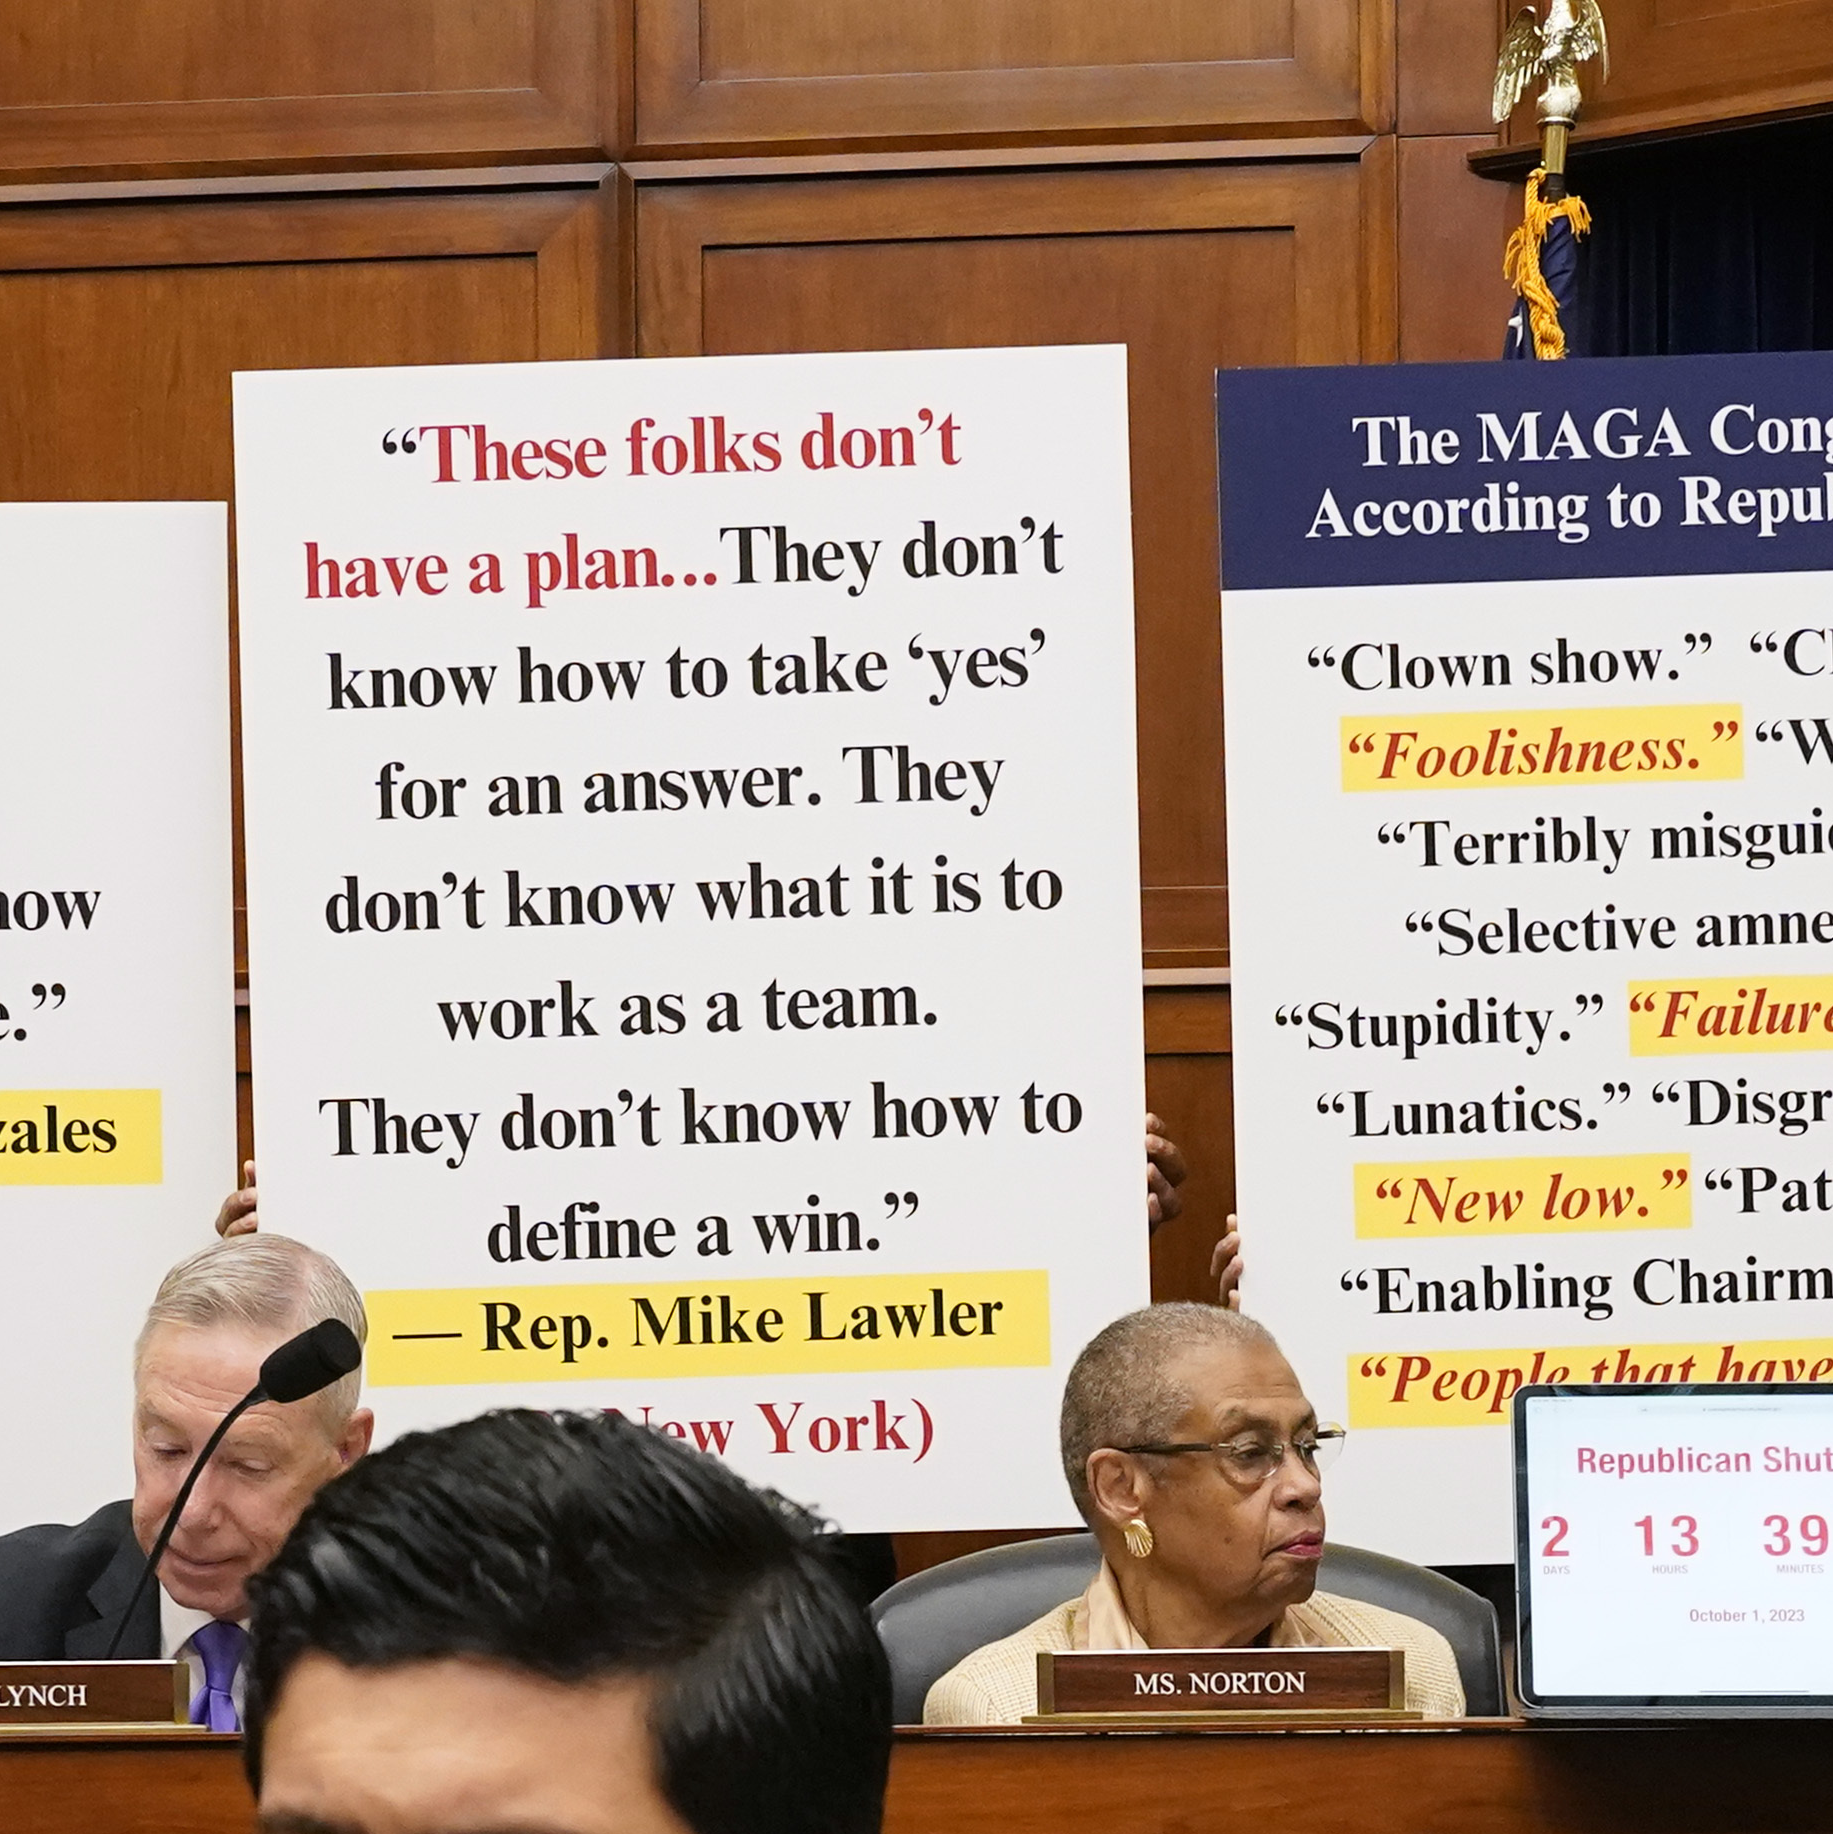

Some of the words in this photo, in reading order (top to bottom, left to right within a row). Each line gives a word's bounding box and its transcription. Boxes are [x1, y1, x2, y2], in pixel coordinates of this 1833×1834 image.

[383, 425, 606, 482] “These
[626, 416, 781, 475] folks
[801, 408, 961, 470] don’t
[1352, 416, 1459, 466] The
[1476, 408, 1691, 462] MAGA
[1305, 482, 1589, 543] According
[1607, 483, 1661, 528] to
[305, 542, 447, 598] have
[469, 554, 504, 593] a
[903, 517, 1063, 578] don’t
[327, 653, 497, 709] know
[518, 647, 645, 703] how
[666, 647, 727, 698] to
[748, 636, 887, 695] take
[909, 628, 1045, 706] ‘yes’
[1308, 644, 1511, 690] “Clown
[1531, 633, 1711, 684] show.”
[1349, 721, 1738, 778] “Foolishness.”
[375, 762, 466, 819] for
[489, 775, 562, 816] an
[584, 767, 820, 813] answer.
[843, 746, 1004, 816] They
[1378, 816, 1630, 874] “Terribly
[326, 872, 485, 933] don’t
[505, 871, 675, 927] know
[696, 862, 849, 920] what
[870, 857, 913, 914] it
[934, 855, 981, 912] is
[1001, 859, 1062, 910] to
[1406, 904, 1675, 956] “Selective
[438, 980, 598, 1040] work
[621, 994, 685, 1035] as
[707, 993, 742, 1032] a
[762, 979, 937, 1030] team.
[1276, 994, 1603, 1059] “Stupidity.”
[319, 1098, 480, 1169] They
[501, 1089, 660, 1151] don’t
[681, 1088, 850, 1144] know
[871, 1082, 999, 1138] how
[1020, 1082, 1082, 1134] to
[1317, 1082, 1630, 1136] “Lunatics.”
[1377, 1177, 1523, 1224] “New
[1544, 1169, 1687, 1220] low.”
[488, 1202, 675, 1262] define
[697, 1216, 732, 1256] a
[753, 1192, 918, 1254] win.”
[1341, 1263, 1613, 1320] “Enabling
[482, 1303, 608, 1363] Rep.
[631, 1295, 783, 1346] Mike
[804, 1289, 1003, 1340] Lawler
[1360, 1351, 1571, 1414] “People
[1591, 1348, 1697, 1383] that
[600, 1405, 735, 1456] ew
[754, 1397, 936, 1465] York)
[1577, 1447, 1751, 1478] Republican
[1541, 1517, 1570, 1556] 2
[1634, 1516, 1699, 1556] 13
[1764, 1516, 1829, 1556] 39
[1543, 1565, 1570, 1575] DAYS
[1652, 1565, 1688, 1574] HOURS
[1776, 1564, 1824, 1574] MINUTES
[1690, 1609, 1746, 1623] October
[1752, 1610, 1765, 1625] 1,
[1770, 1609, 1804, 1623] 2023
[1134, 1673, 1181, 1694] MS.
[1189, 1672, 1305, 1694] NORTON
